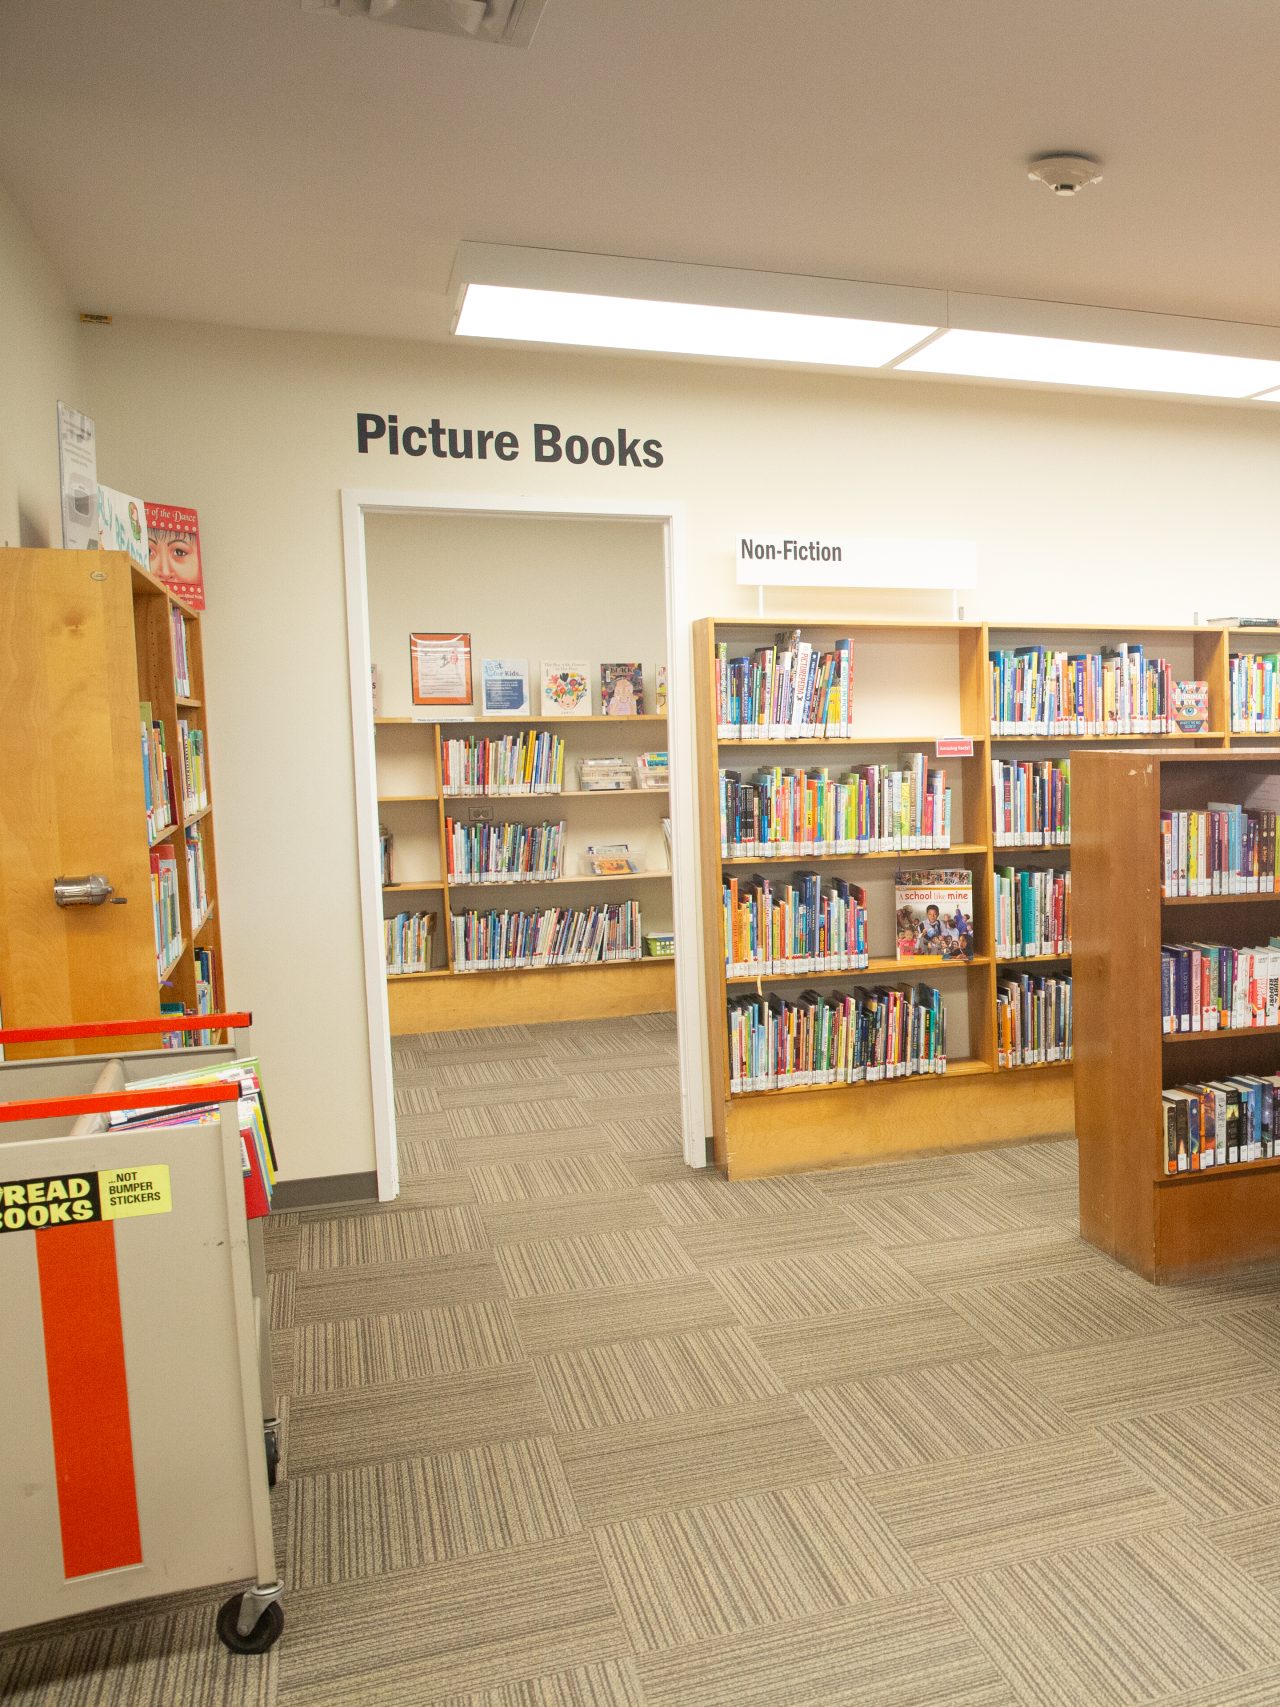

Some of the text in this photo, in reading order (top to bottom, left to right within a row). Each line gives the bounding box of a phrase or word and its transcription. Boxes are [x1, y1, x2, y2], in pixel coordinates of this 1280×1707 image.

[356, 412, 663, 467] Picture Books
[151, 507, 159, 520] of
[160, 508, 171, 519] the
[173, 510, 196, 523] Dance
[741, 538, 841, 561] Non-Fiction
[904, 890, 932, 900] school
[947, 891, 969, 900] mine
[3, 1178, 91, 1207] READ
[109, 1181, 153, 1195] BUMPER
[109, 1191, 161, 1206] STICKERS
[0, 1199, 94, 1229] OOKS
